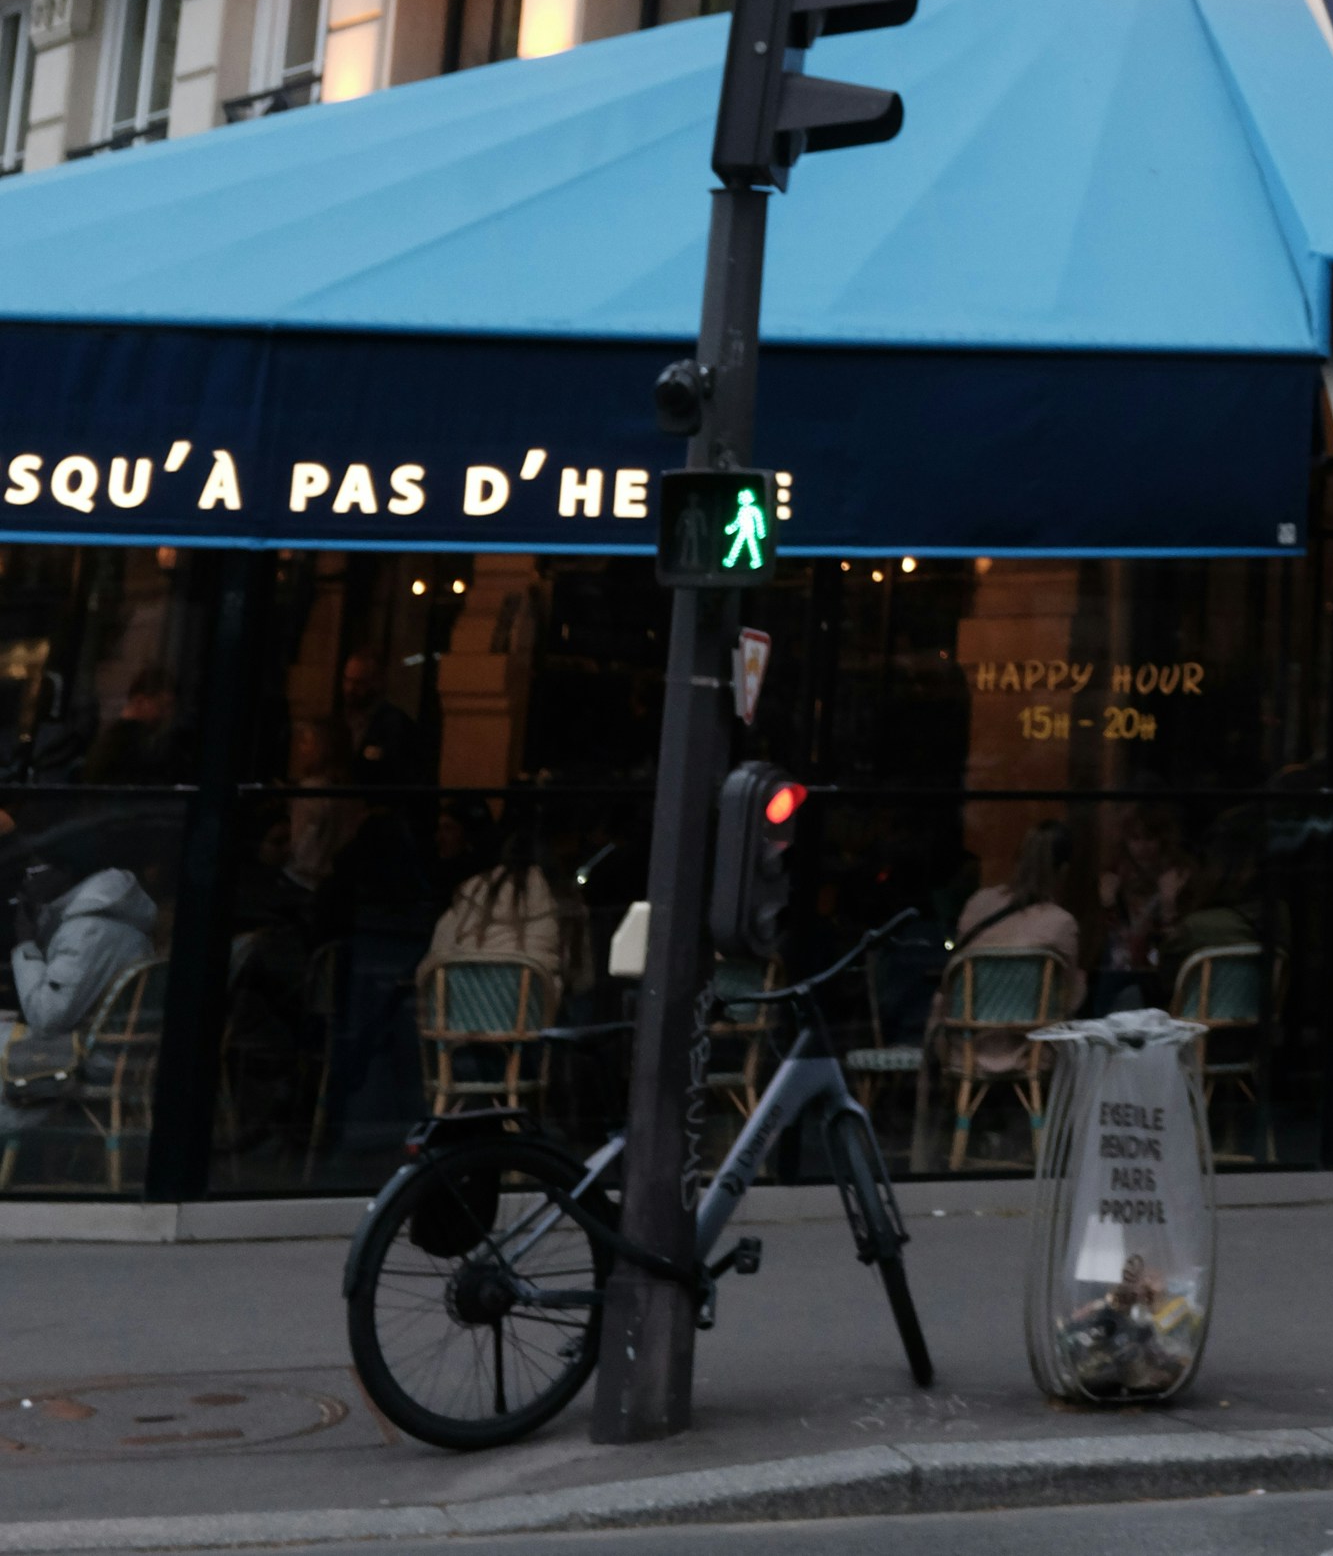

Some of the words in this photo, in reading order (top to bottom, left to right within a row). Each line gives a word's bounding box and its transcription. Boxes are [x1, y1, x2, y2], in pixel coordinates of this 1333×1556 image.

[288, 461, 426, 516] PAS
[462, 448, 793, 521] D'HE
[976, 659, 1094, 694] HAPPY
[1111, 661, 1205, 695] HOUR
